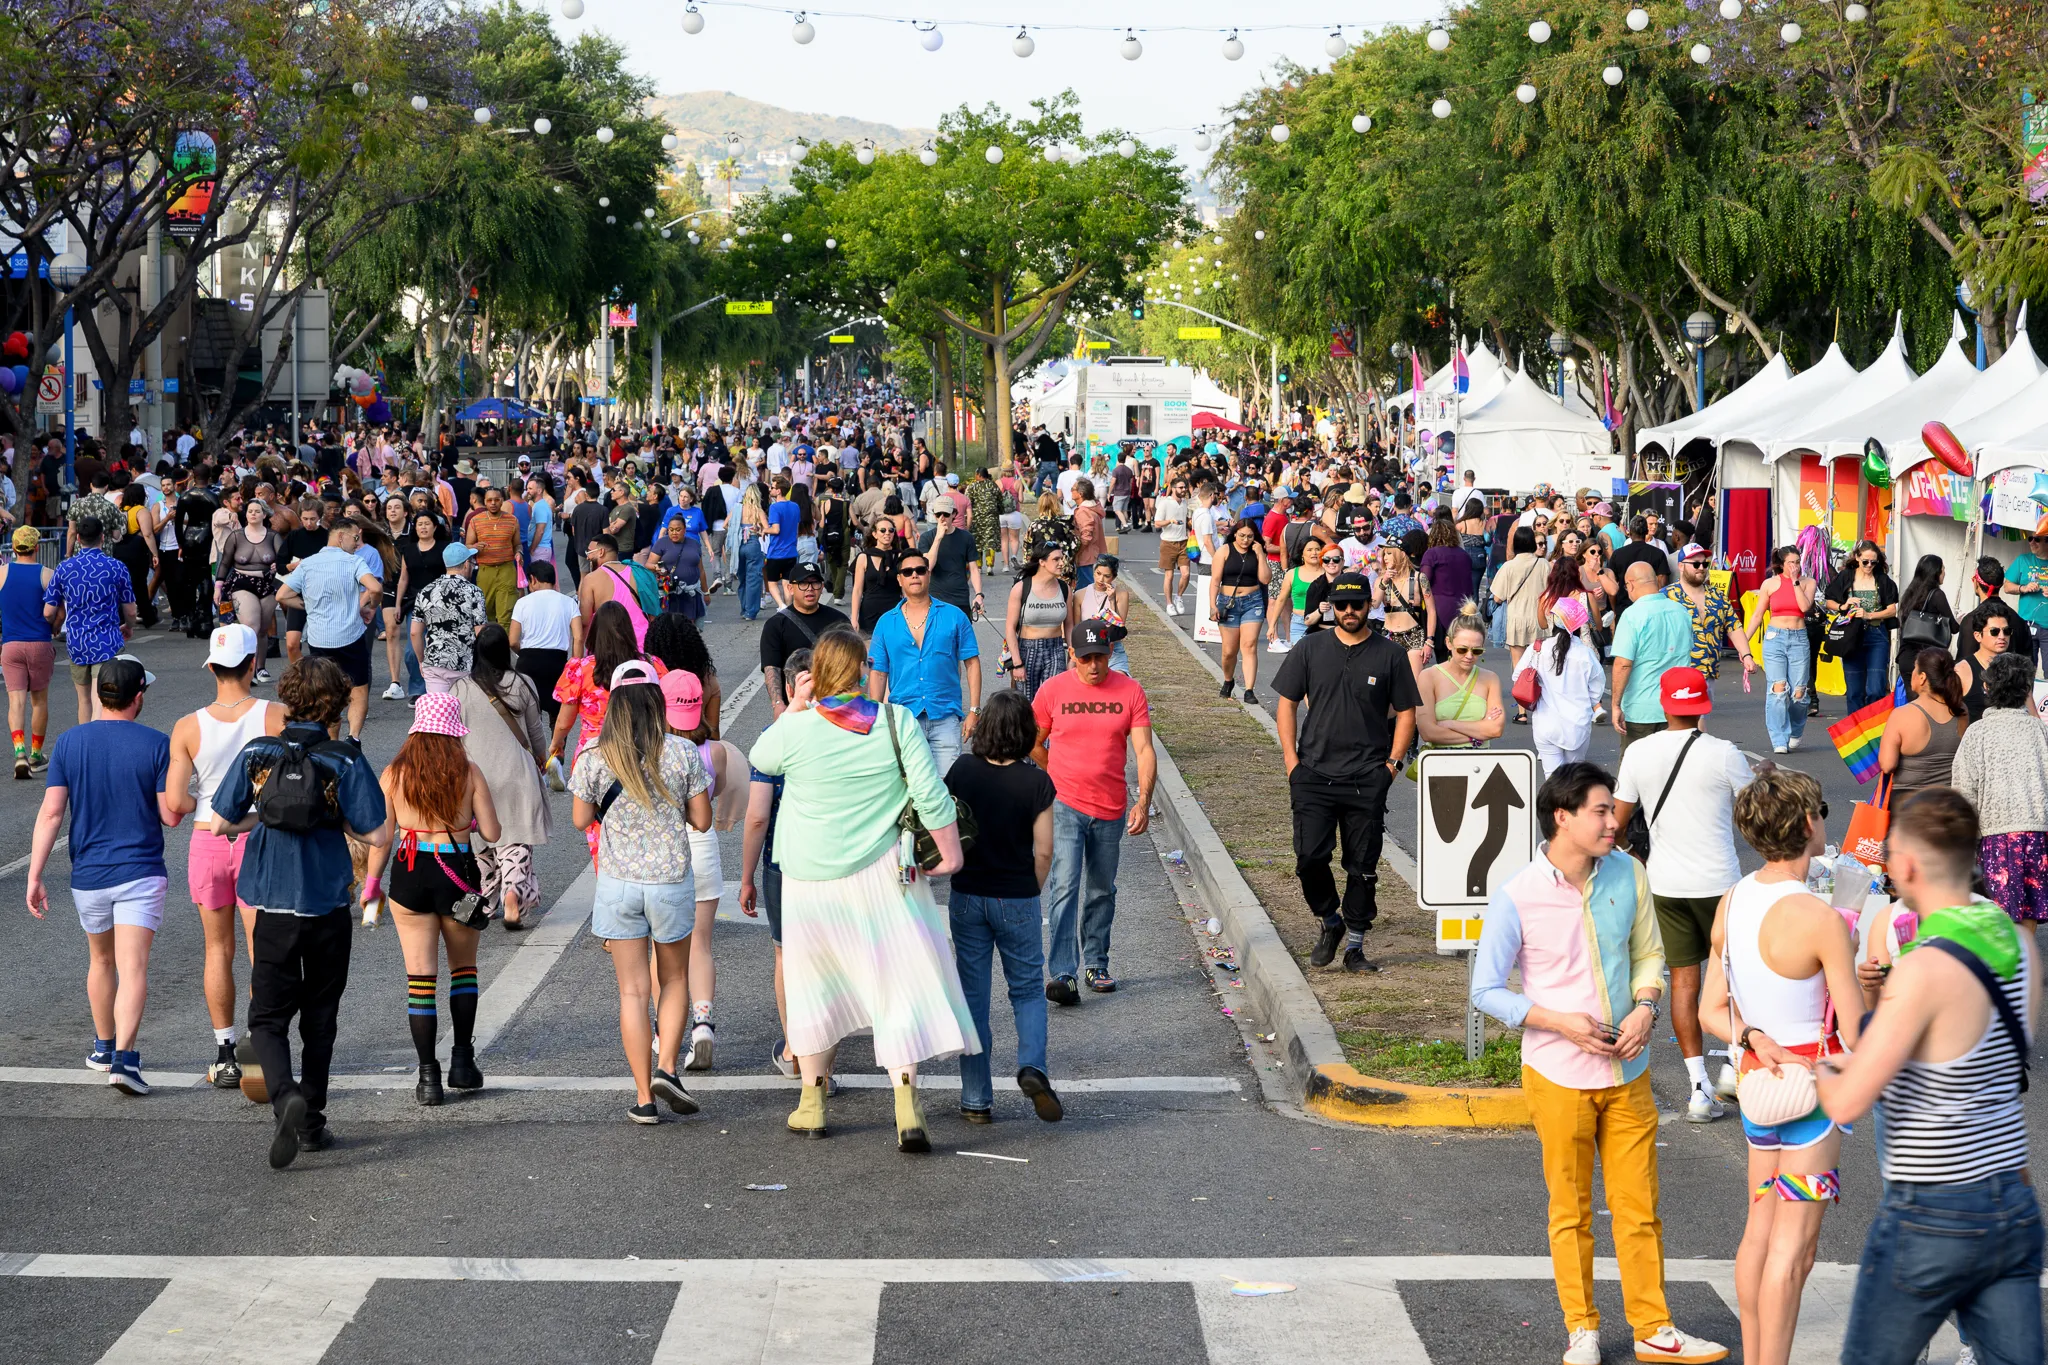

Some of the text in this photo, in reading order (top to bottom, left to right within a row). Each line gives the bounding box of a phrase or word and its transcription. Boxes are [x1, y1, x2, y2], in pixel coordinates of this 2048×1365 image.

[748, 303, 766, 311] XING
[1647, 451, 1663, 462] Dr.
[1086, 629, 1097, 643] LA
[1061, 701, 1124, 715] HONCHO
